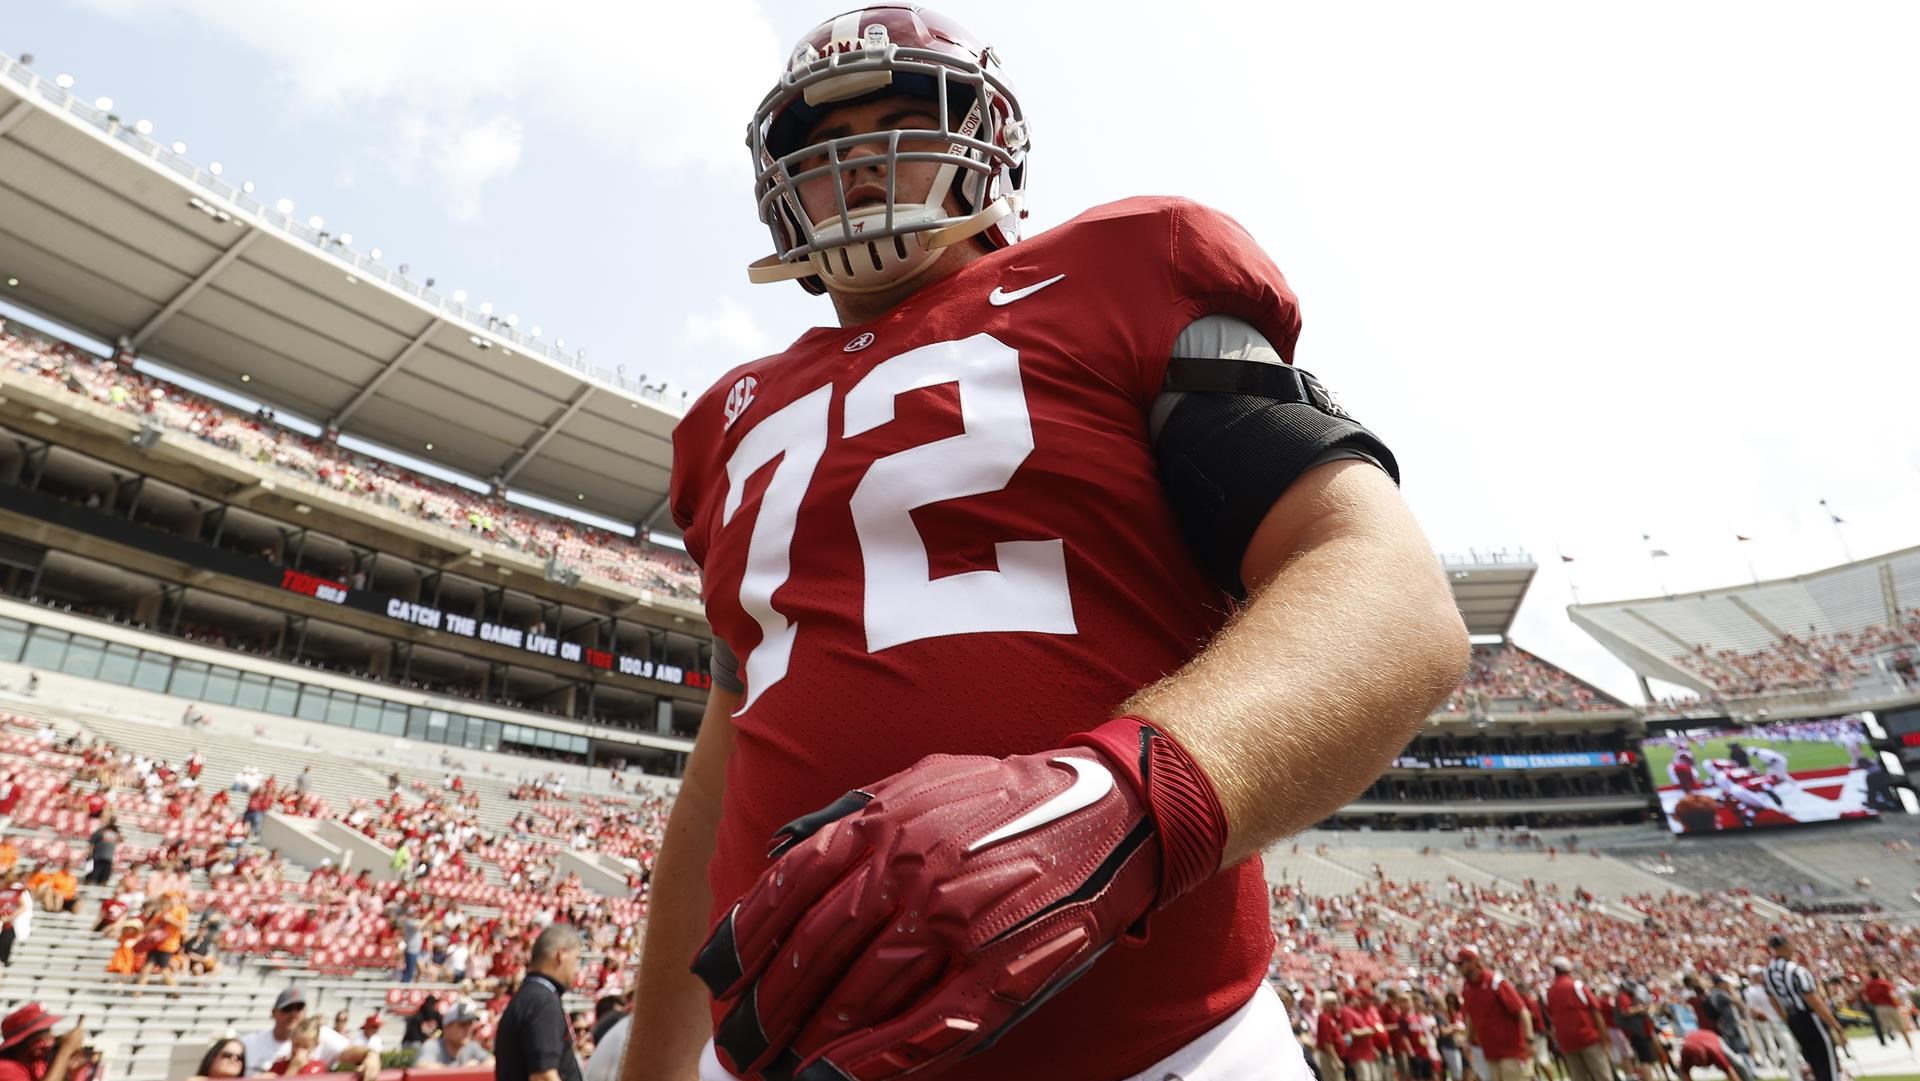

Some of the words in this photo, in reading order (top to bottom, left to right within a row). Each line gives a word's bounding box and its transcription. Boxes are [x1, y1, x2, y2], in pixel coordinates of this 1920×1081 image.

[723, 376, 758, 432] SEC
[723, 332, 1079, 718] 72
[387, 598, 441, 629] CATCH
[446, 613, 477, 637] THE
[480, 622, 523, 648] GAME
[526, 634, 558, 656] LIVE
[560, 642, 581, 663] ON
[619, 655, 653, 678] 100.9
[655, 663, 683, 684] AND
